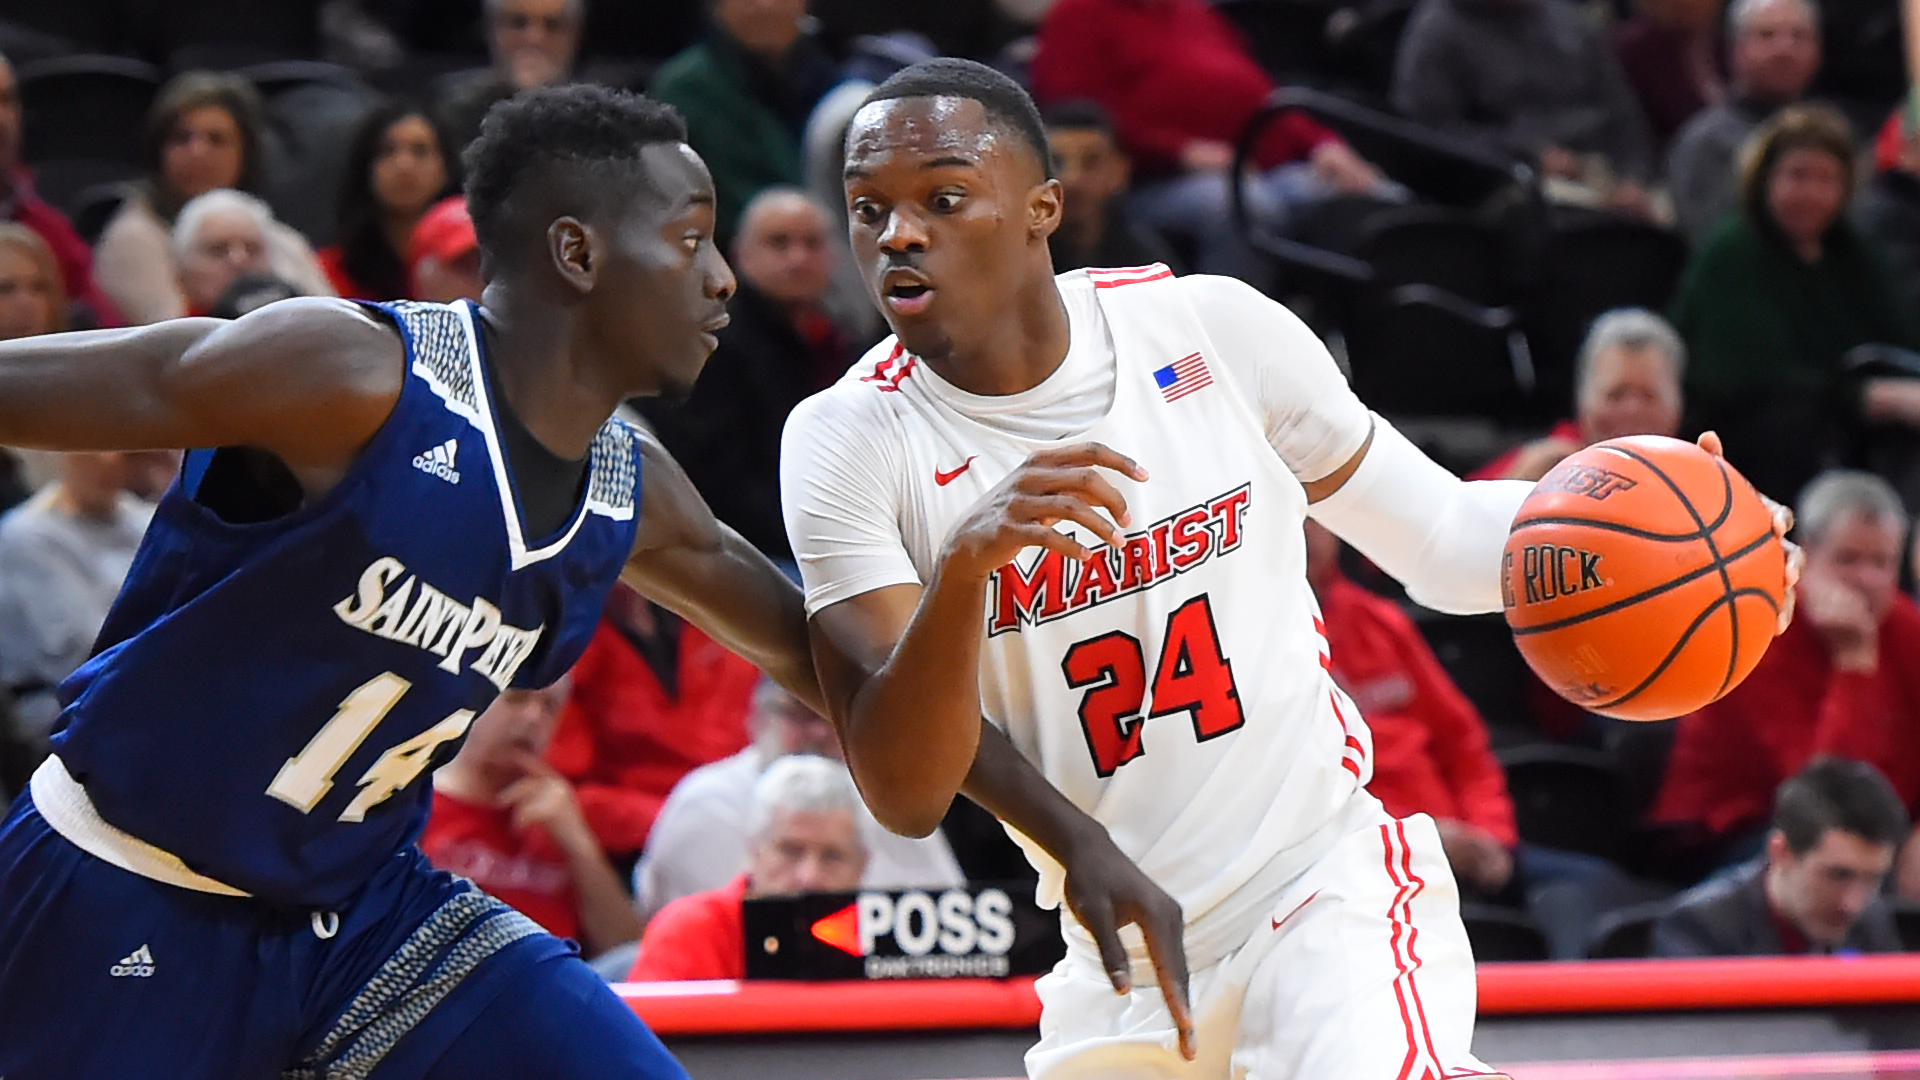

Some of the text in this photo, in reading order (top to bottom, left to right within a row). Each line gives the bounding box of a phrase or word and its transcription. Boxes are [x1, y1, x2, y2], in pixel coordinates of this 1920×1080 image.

[412, 455, 460, 485] adidas
[988, 481, 1251, 638] MARIST
[1523, 543, 1604, 605] ROCK
[1060, 592, 1246, 779] 24
[264, 670, 477, 823] 14
[857, 889, 1016, 956] POSS
